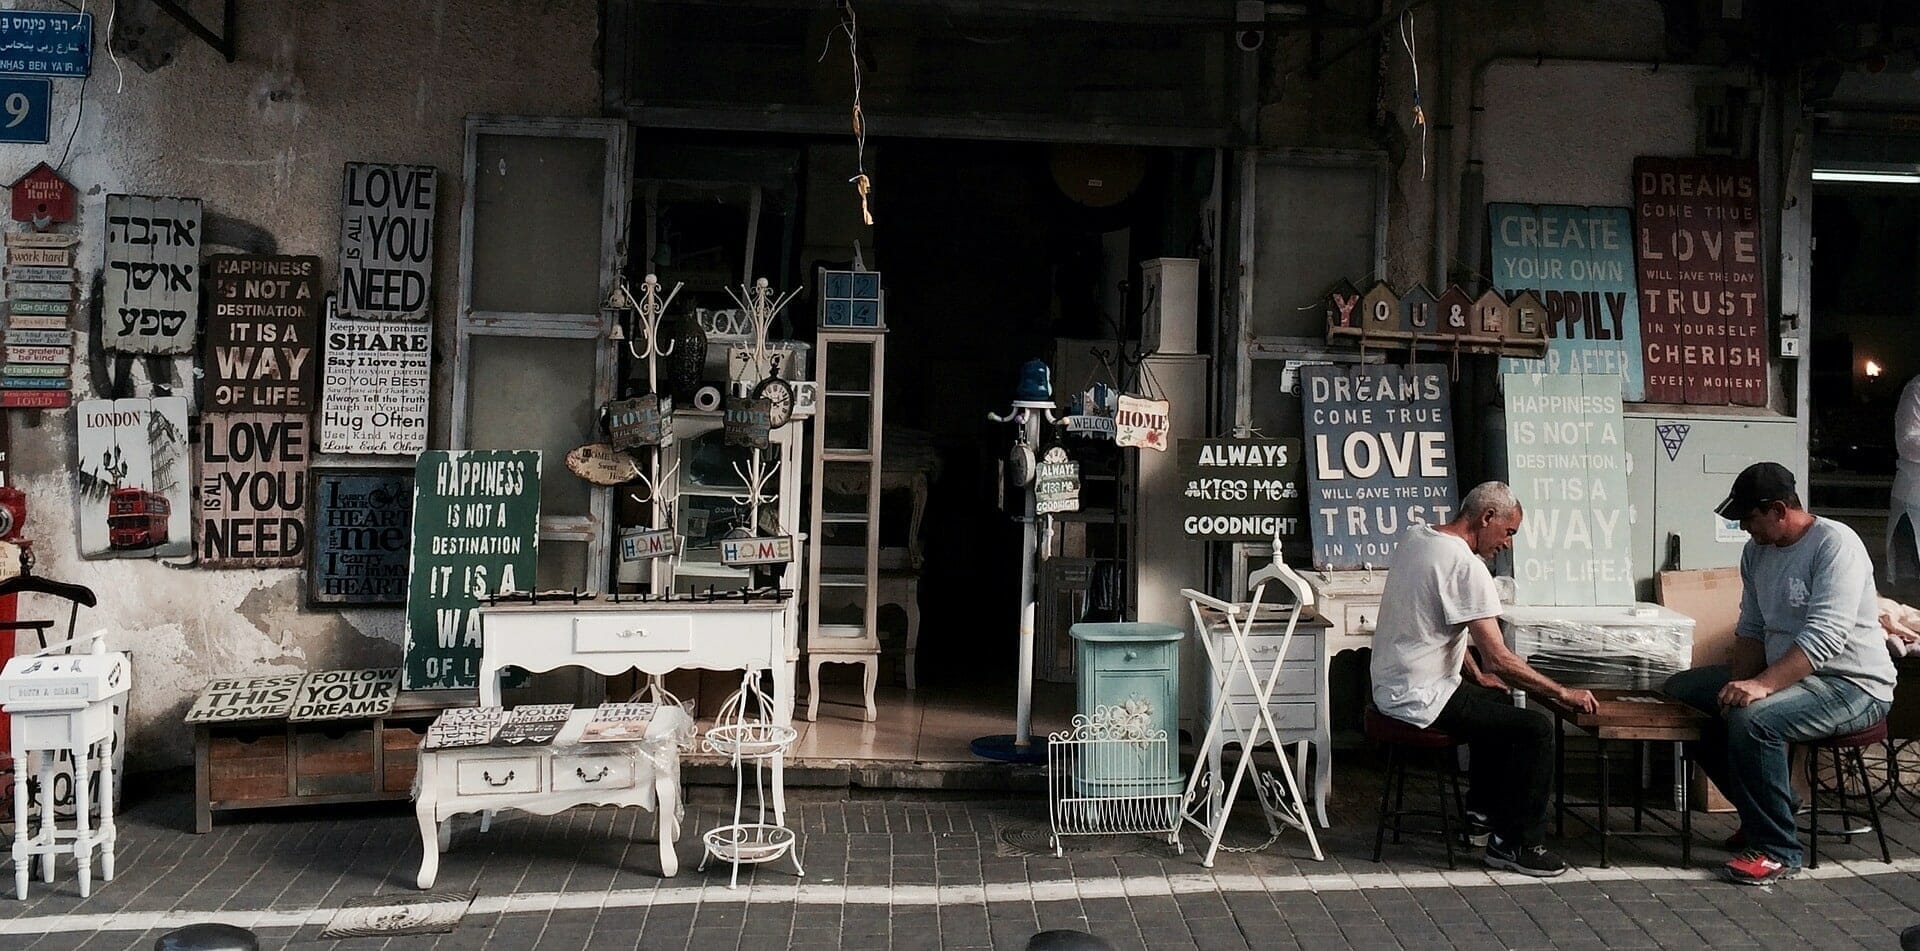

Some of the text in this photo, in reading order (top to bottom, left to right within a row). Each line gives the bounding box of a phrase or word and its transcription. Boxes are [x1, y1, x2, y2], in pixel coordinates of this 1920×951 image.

[28, 61, 47, 71] BEN
[5, 93, 30, 128] 9
[24, 179, 64, 190] Family
[348, 168, 433, 210] LOVE
[1641, 172, 1752, 198] DREAMS
[1642, 203, 1753, 220] COME TRUE
[109, 217, 196, 247] אהבה
[367, 215, 430, 263] YOU
[1500, 215, 1620, 250] CREATE
[1642, 227, 1756, 263] LOVE
[14, 251, 64, 262] work hard
[110, 260, 194, 293] אושר
[217, 260, 312, 276] HAPPINESS
[1503, 256, 1624, 281] YOUR OWN
[1646, 270, 1673, 280] WILL
[1708, 271, 1729, 281] THE
[1732, 272, 1754, 283] DAY
[218, 281, 312, 299] IS NOT A
[341, 267, 426, 312] NEED
[1644, 289, 1757, 316] TRUST
[118, 308, 187, 337] שפע
[695, 308, 754, 336] LOV
[1503, 289, 1627, 340] PPILY
[230, 323, 298, 342] IT IS A
[329, 322, 429, 334] Keep your promises
[1648, 322, 1757, 337] IN YOURSELF
[329, 333, 428, 352] SHARE
[215, 346, 311, 381] WAY
[327, 357, 427, 369] Say I love you
[1647, 343, 1761, 367] CHERISH
[350, 376, 388, 386] YOUR
[391, 376, 426, 387] BEST
[1311, 375, 1441, 403] DREAMS
[1650, 375, 1762, 388] EVERY MOMENT
[215, 385, 246, 405] OF
[326, 394, 360, 403] Always
[382, 395, 398, 403] the
[401, 395, 426, 404] Truth
[1512, 395, 1616, 414] HAPPINESS
[326, 402, 360, 412] Laugh
[378, 403, 423, 412] Yourself
[1313, 408, 1442, 424] COME TRUE
[86, 411, 141, 428] LONDON
[324, 411, 425, 431] Hug Often
[1073, 416, 1116, 431] WELCO
[1118, 410, 1167, 431] HOME
[204, 421, 304, 463] LOVE
[352, 431, 381, 440] Kind
[389, 432, 425, 440] Words
[1513, 421, 1618, 445] IS NOT A
[1198, 445, 1288, 467] ALWAYS
[1315, 430, 1448, 480] LOVE
[1515, 454, 1618, 469] DESTINATION.
[436, 460, 525, 497] HAPPINESS
[1041, 463, 1074, 477] ALWAYS
[204, 473, 222, 511] IS ALL
[221, 471, 304, 512] YOU
[1200, 478, 1248, 500] KISS
[1321, 486, 1448, 500] WILL THE DAY
[1533, 477, 1608, 501] IT IS A
[447, 503, 507, 529] IS NOT A
[1184, 516, 1298, 535] GOODNIGHT
[1320, 505, 1452, 536] TRUST
[204, 518, 305, 558] NEED
[1522, 509, 1620, 549] WAY
[432, 535, 521, 555] DESTINATION
[1325, 543, 1344, 556] IN
[1524, 558, 1555, 581] OF
[430, 563, 516, 598] IT IS A
[436, 608, 482, 649] WA
[311, 668, 398, 684] FOLLOW
[425, 657, 453, 679] OF
[211, 676, 299, 691] BLESS
[307, 682, 394, 703] YOUR
[208, 688, 292, 708] THIS
[296, 699, 389, 718] DREAMS
[192, 704, 285, 719] HOME
[601, 708, 652, 717] THIS
